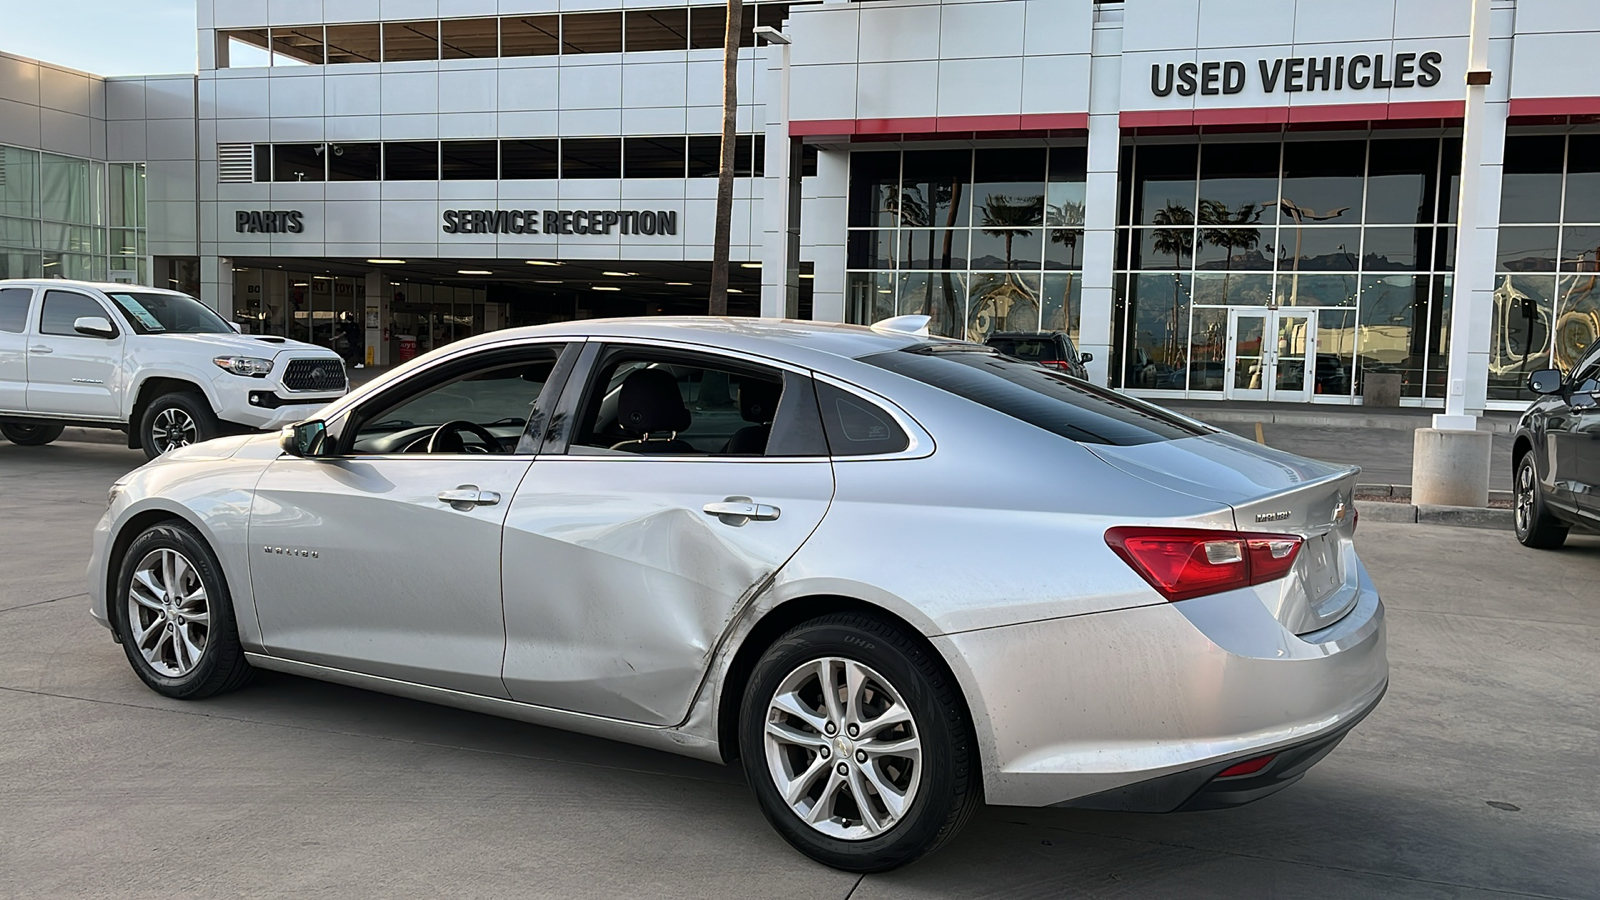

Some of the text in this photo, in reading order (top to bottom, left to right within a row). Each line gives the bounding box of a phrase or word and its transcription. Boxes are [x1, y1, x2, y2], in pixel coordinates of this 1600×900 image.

[1151, 51, 1442, 97] USED VEHICLES
[235, 210, 304, 233] PARTS
[442, 210, 677, 235] SERVICE RECEPTION
[843, 635, 876, 650] UHP
